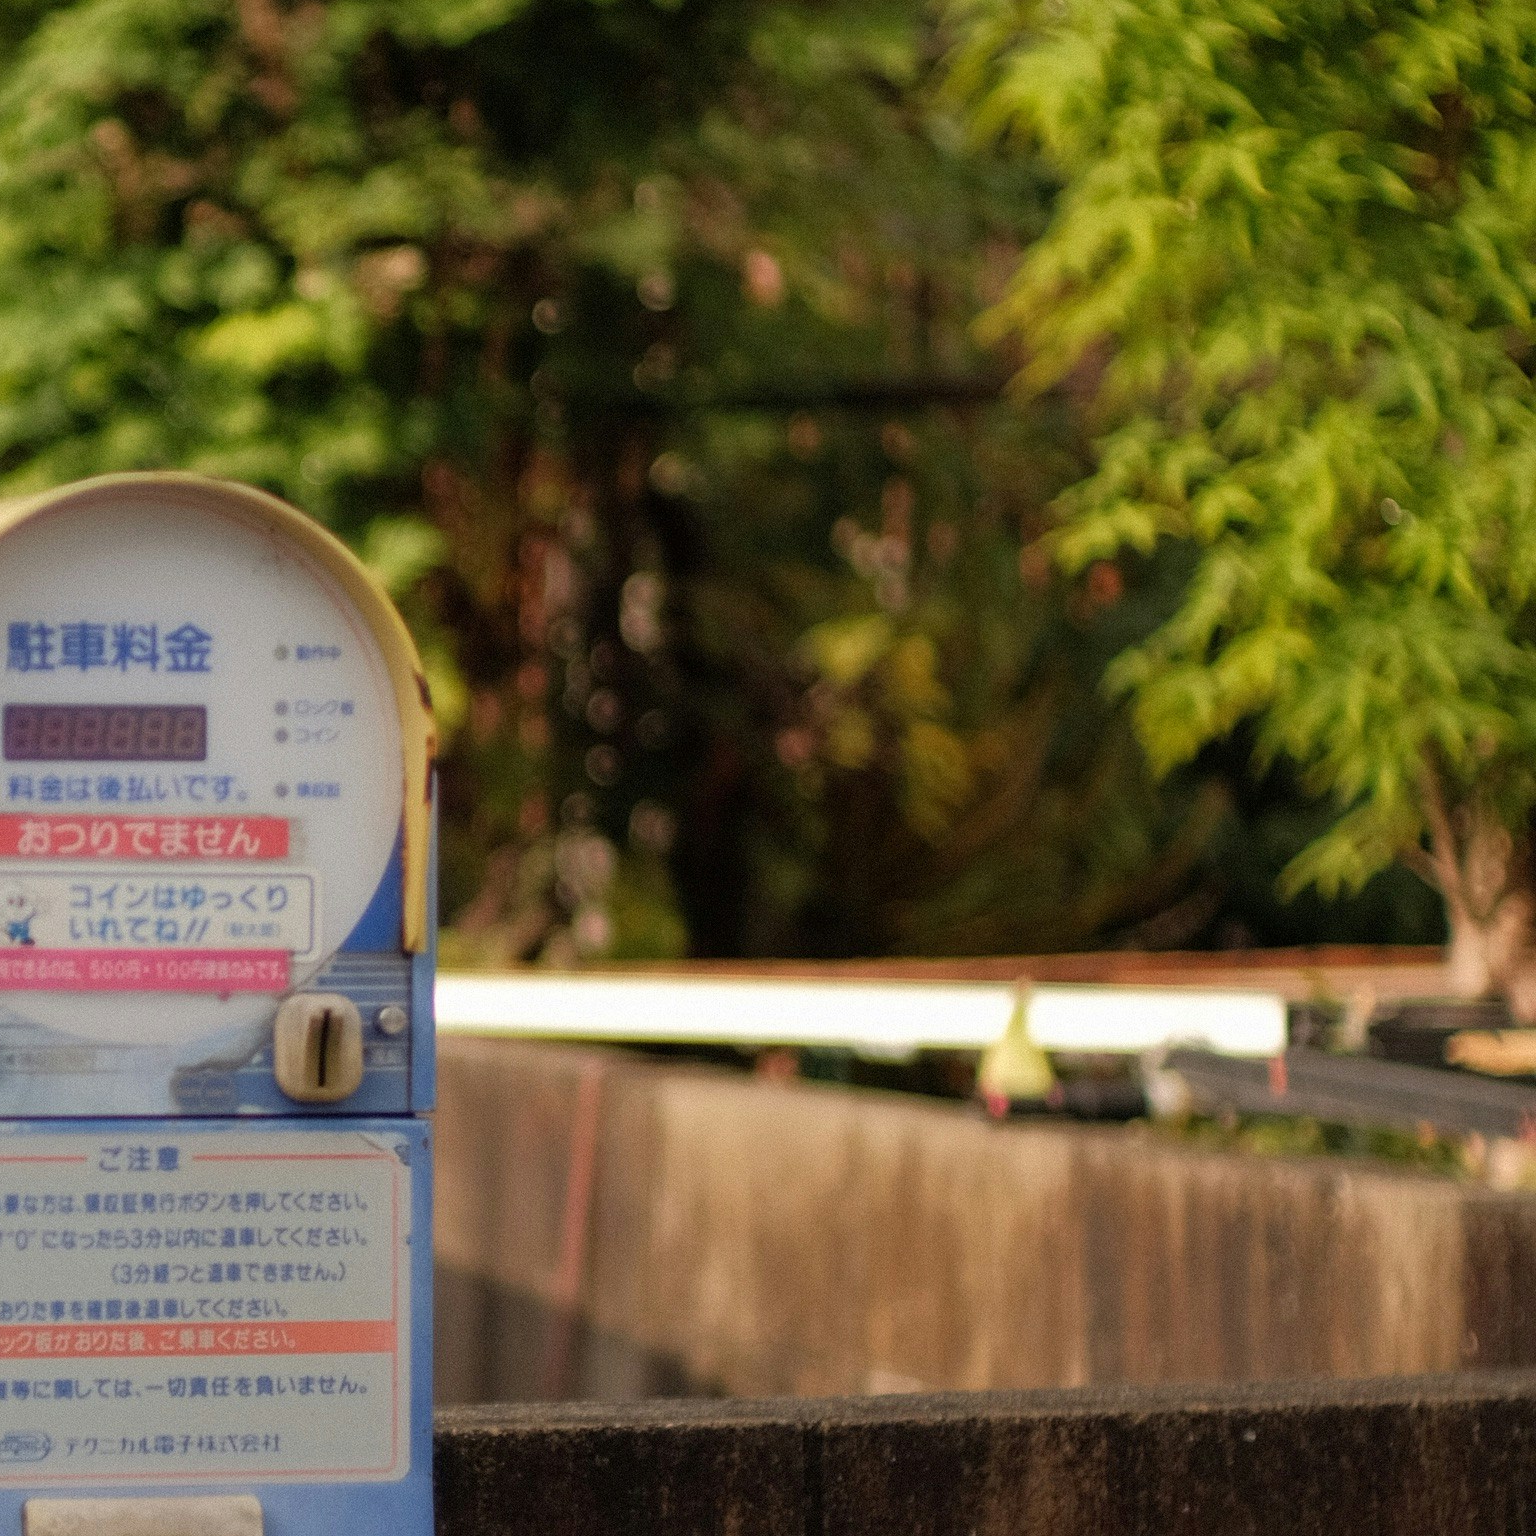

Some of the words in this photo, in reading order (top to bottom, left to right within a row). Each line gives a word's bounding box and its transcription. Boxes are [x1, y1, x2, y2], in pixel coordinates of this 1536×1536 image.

[7, 619, 213, 673] 駐車料金
[8, 775, 248, 802] 料金は後払いです。
[17, 820, 261, 855] おつりでません
[70, 883, 289, 913] コインはゆっくり
[98, 1145, 180, 1173] ご注意
